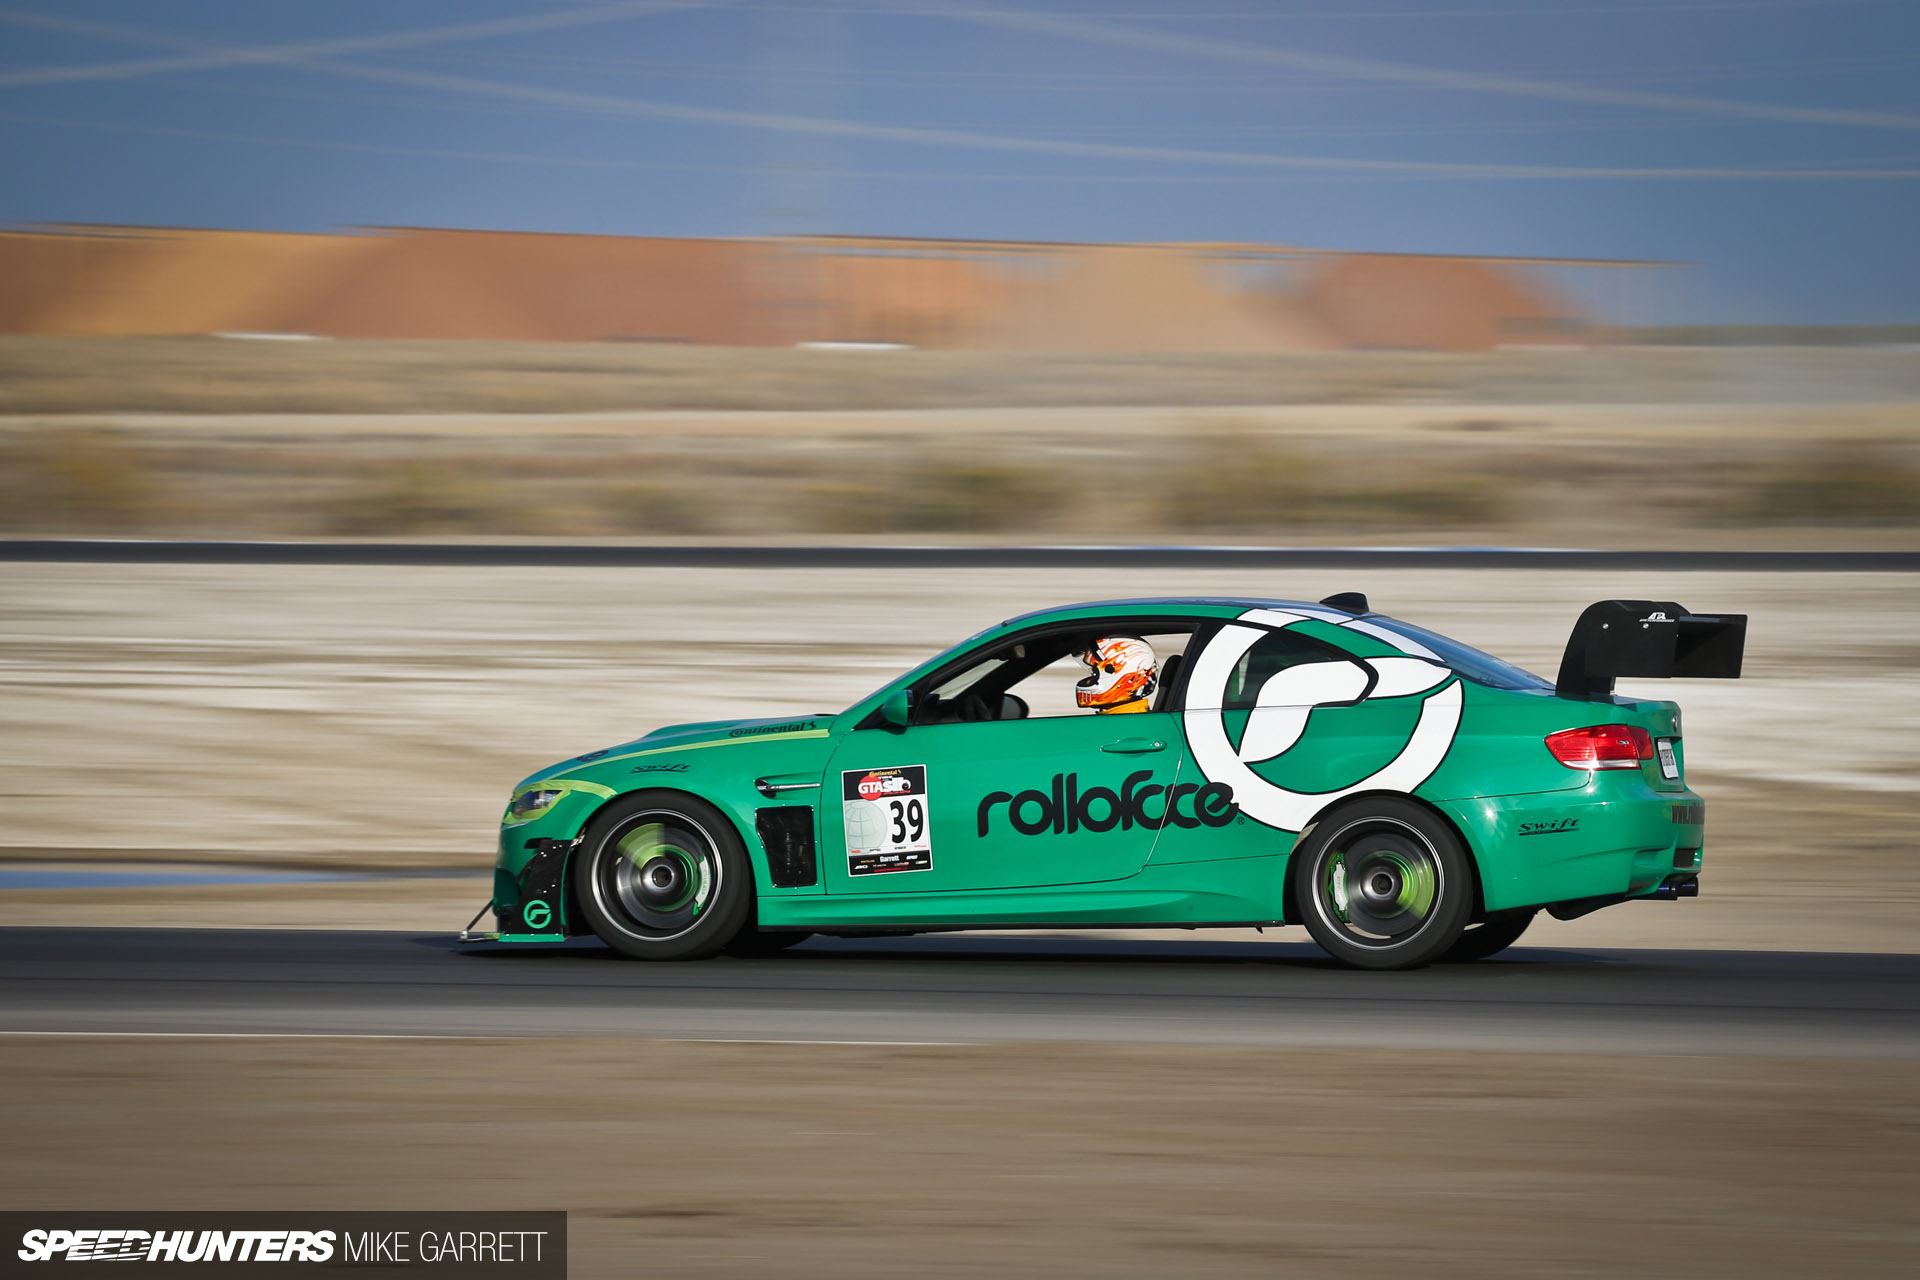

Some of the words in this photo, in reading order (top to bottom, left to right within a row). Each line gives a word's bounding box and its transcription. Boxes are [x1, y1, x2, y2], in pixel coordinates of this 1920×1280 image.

[729, 722, 806, 737] Continental
[890, 799, 924, 844] 39
[977, 770, 1239, 838] rolloface
